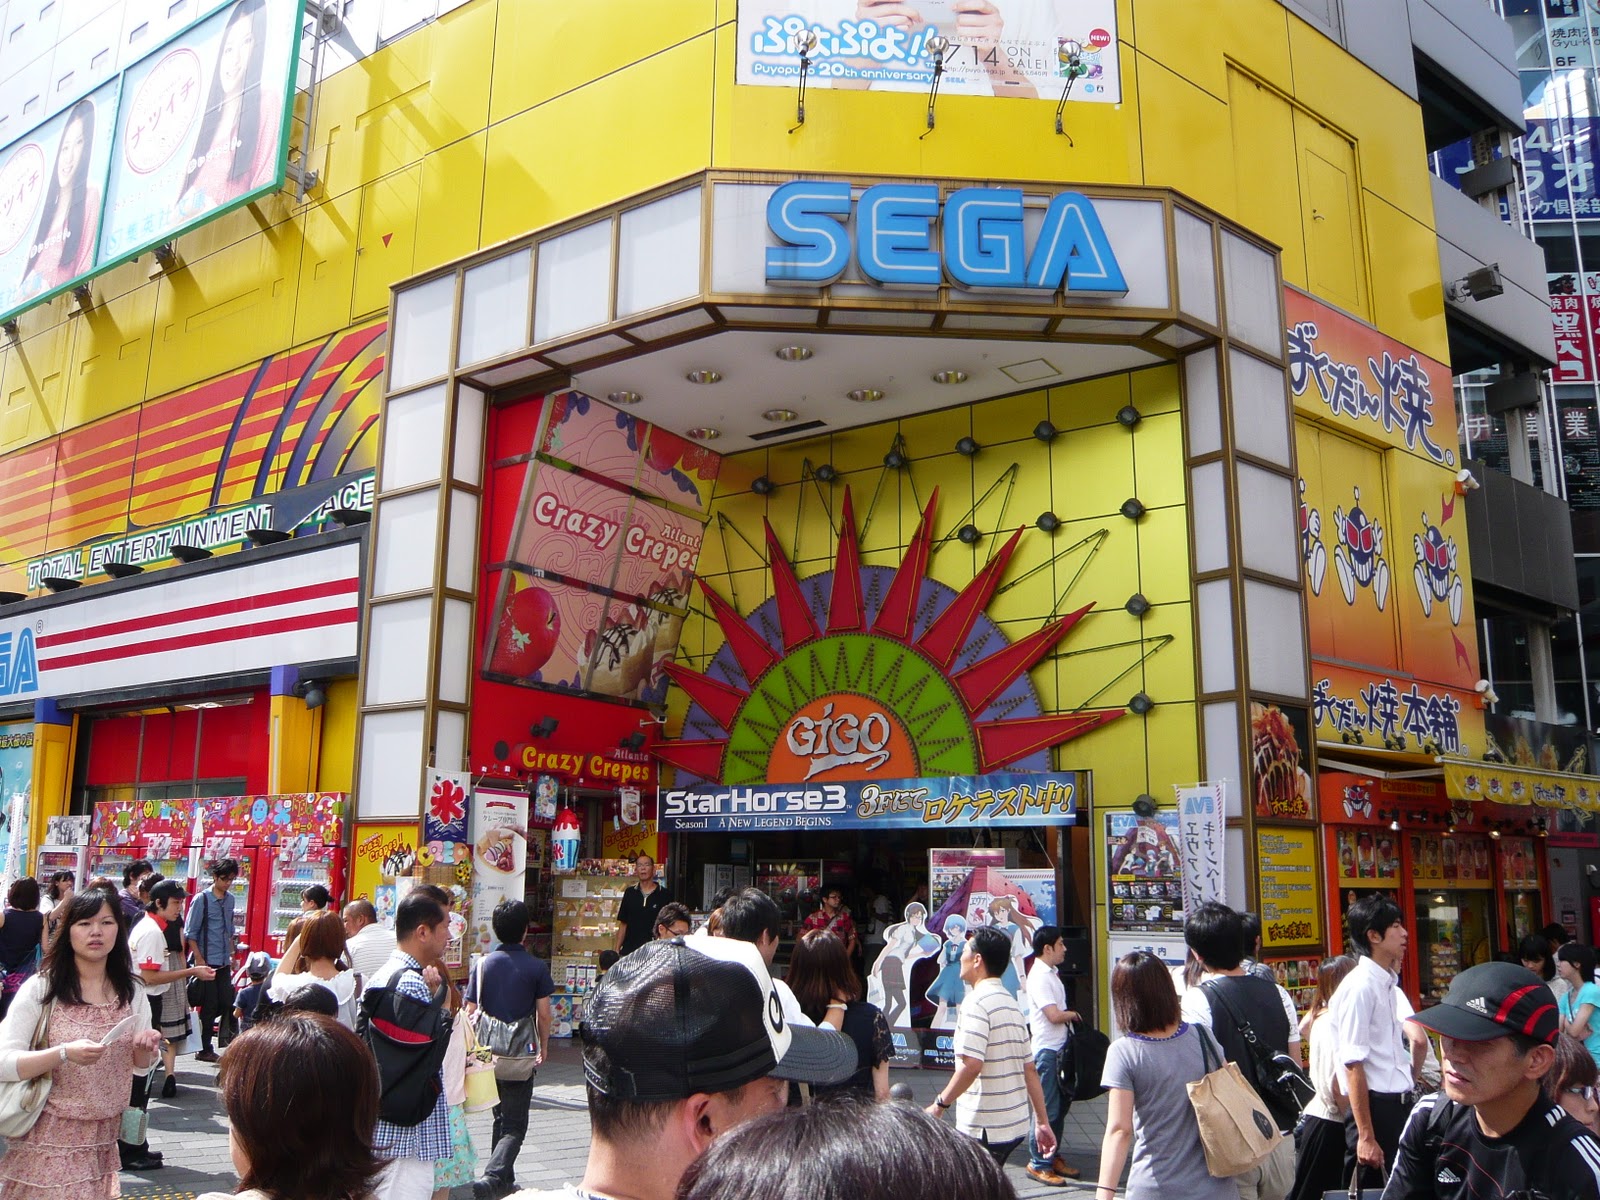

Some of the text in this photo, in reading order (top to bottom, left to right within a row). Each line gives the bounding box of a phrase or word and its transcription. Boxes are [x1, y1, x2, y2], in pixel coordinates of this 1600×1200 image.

[944, 44, 1031, 67] 7.14 ON
[1555, 56, 1577, 67] 6F
[754, 62, 935, 82] Puyopuo 20th anniversary
[765, 180, 1129, 298] SEGA
[534, 492, 699, 572] Crazy Crepes
[661, 523, 701, 549] Atlant
[28, 552, 84, 591] TOTAL
[88, 503, 275, 573] ENTERTAINMENT
[522, 746, 649, 783] Crazy Crepes
[614, 748, 649, 761] Atlanta
[429, 778, 467, 826] 氷
[664, 784, 847, 815] StarHorse3
[718, 818, 726, 828] A
[728, 817, 752, 829] NEW
[754, 816, 793, 828] LEGEND
[357, 833, 384, 857] Crazy
